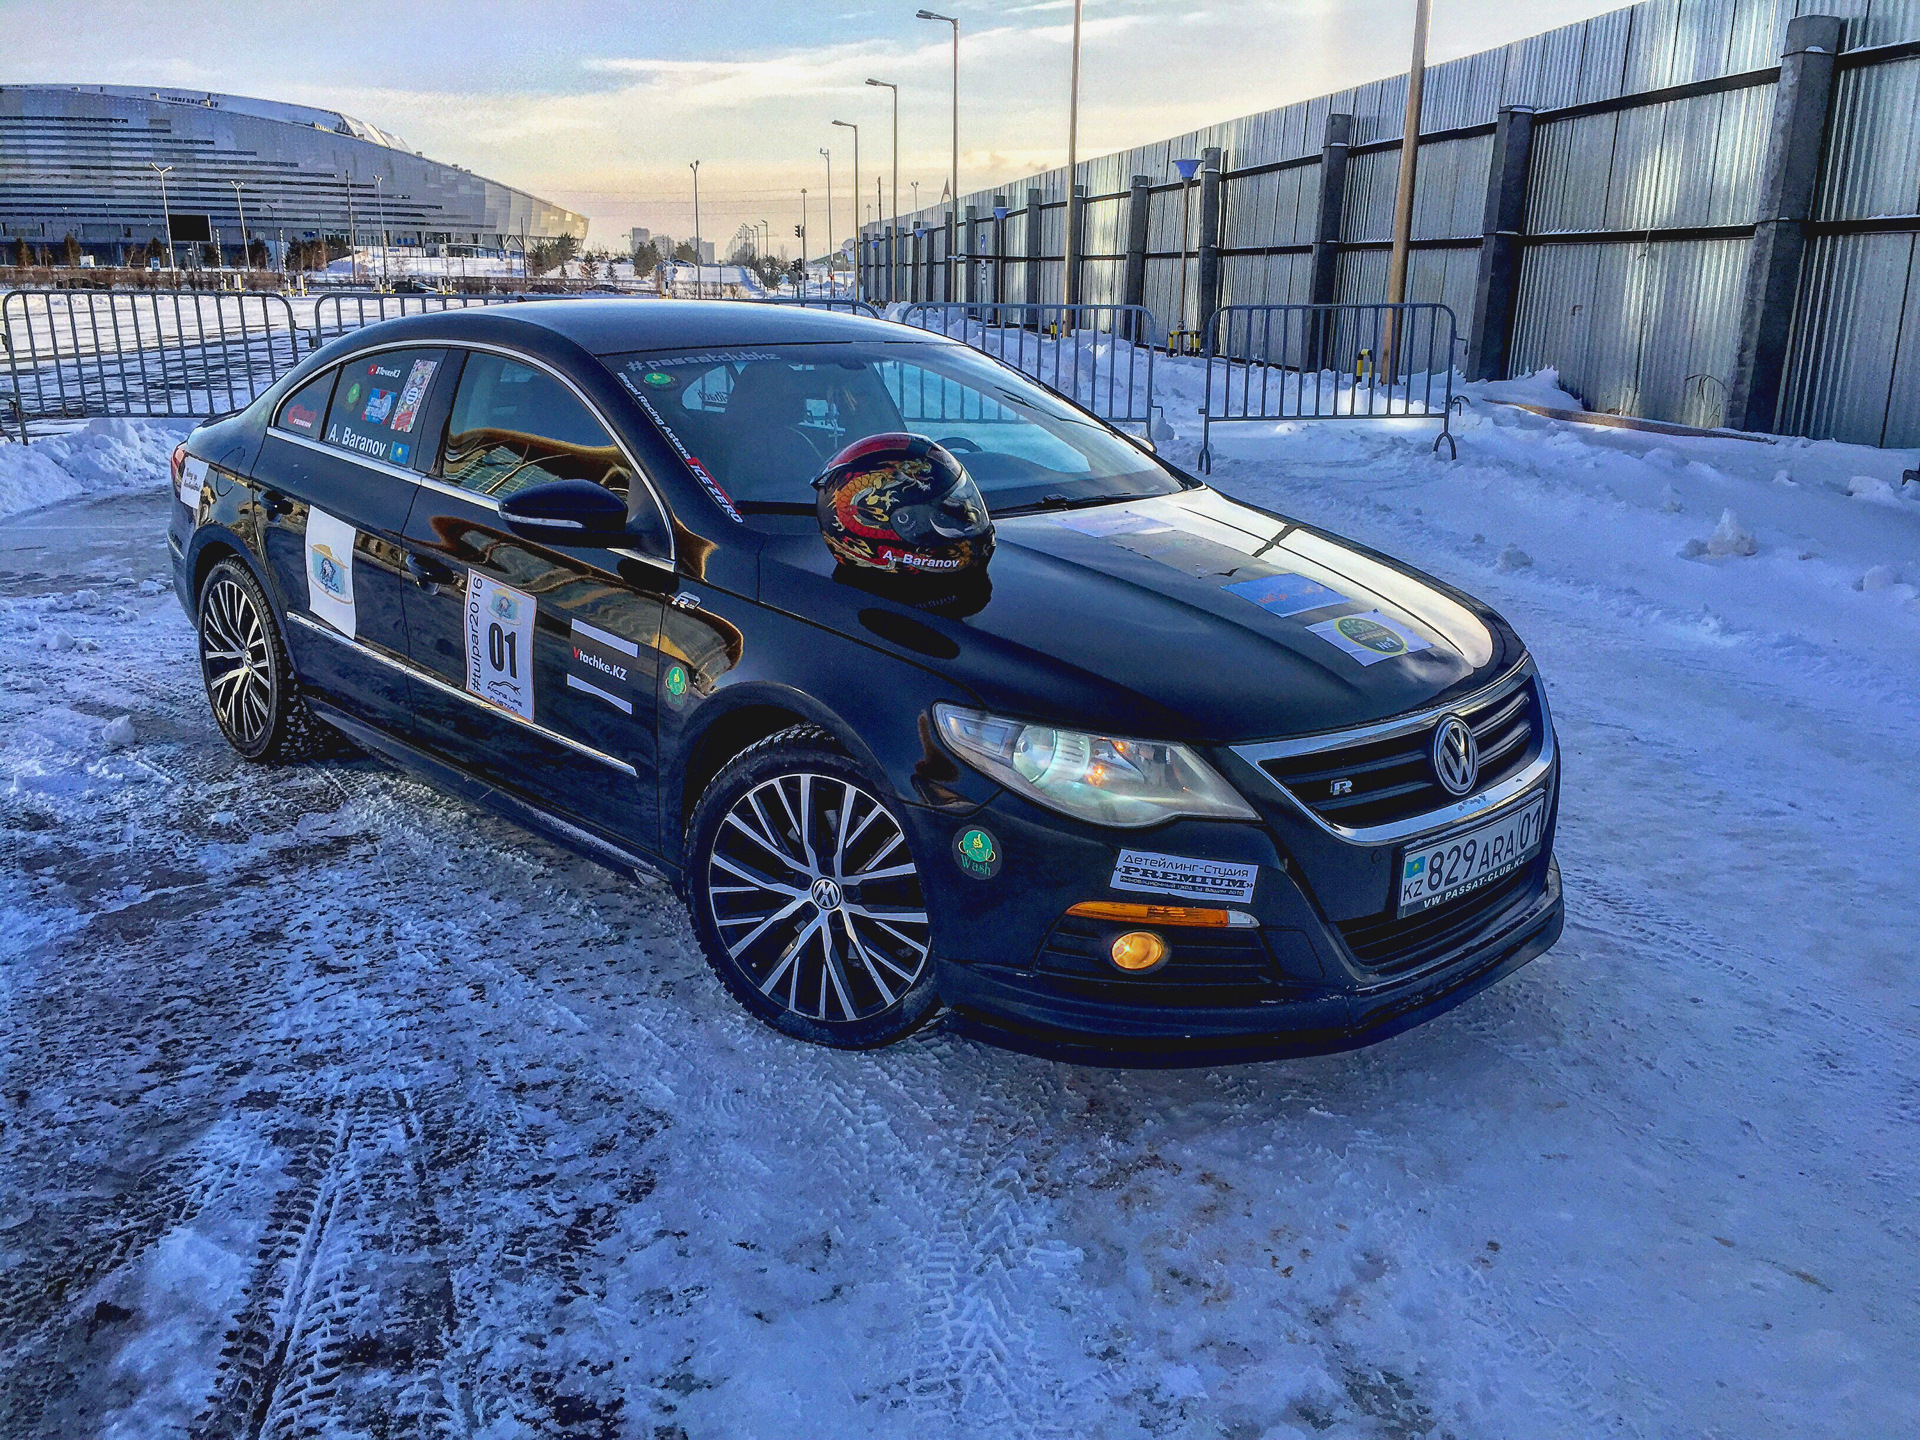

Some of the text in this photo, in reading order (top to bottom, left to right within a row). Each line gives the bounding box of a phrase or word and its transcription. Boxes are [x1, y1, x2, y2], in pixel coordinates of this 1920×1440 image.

[626, 352, 781, 372] #passatclubkz
[328, 423, 387, 457] A. Baranov
[637, 395, 665, 425] Racing
[662, 426, 692, 460] Astana
[690, 465, 744, 523] ICE ZERO
[902, 553, 960, 568] Baranov
[471, 576, 483, 692] #tulpar2016
[489, 622, 518, 680] 01
[572, 646, 628, 682] Vtachke.KZ
[1330, 777, 1353, 797] R
[960, 854, 991, 877] Wash
[1123, 854, 1249, 878] Детейлинг-Студия
[1422, 854, 1526, 909] VW PASSAT-CLUB.KZ
[1402, 879, 1423, 902] KZ
